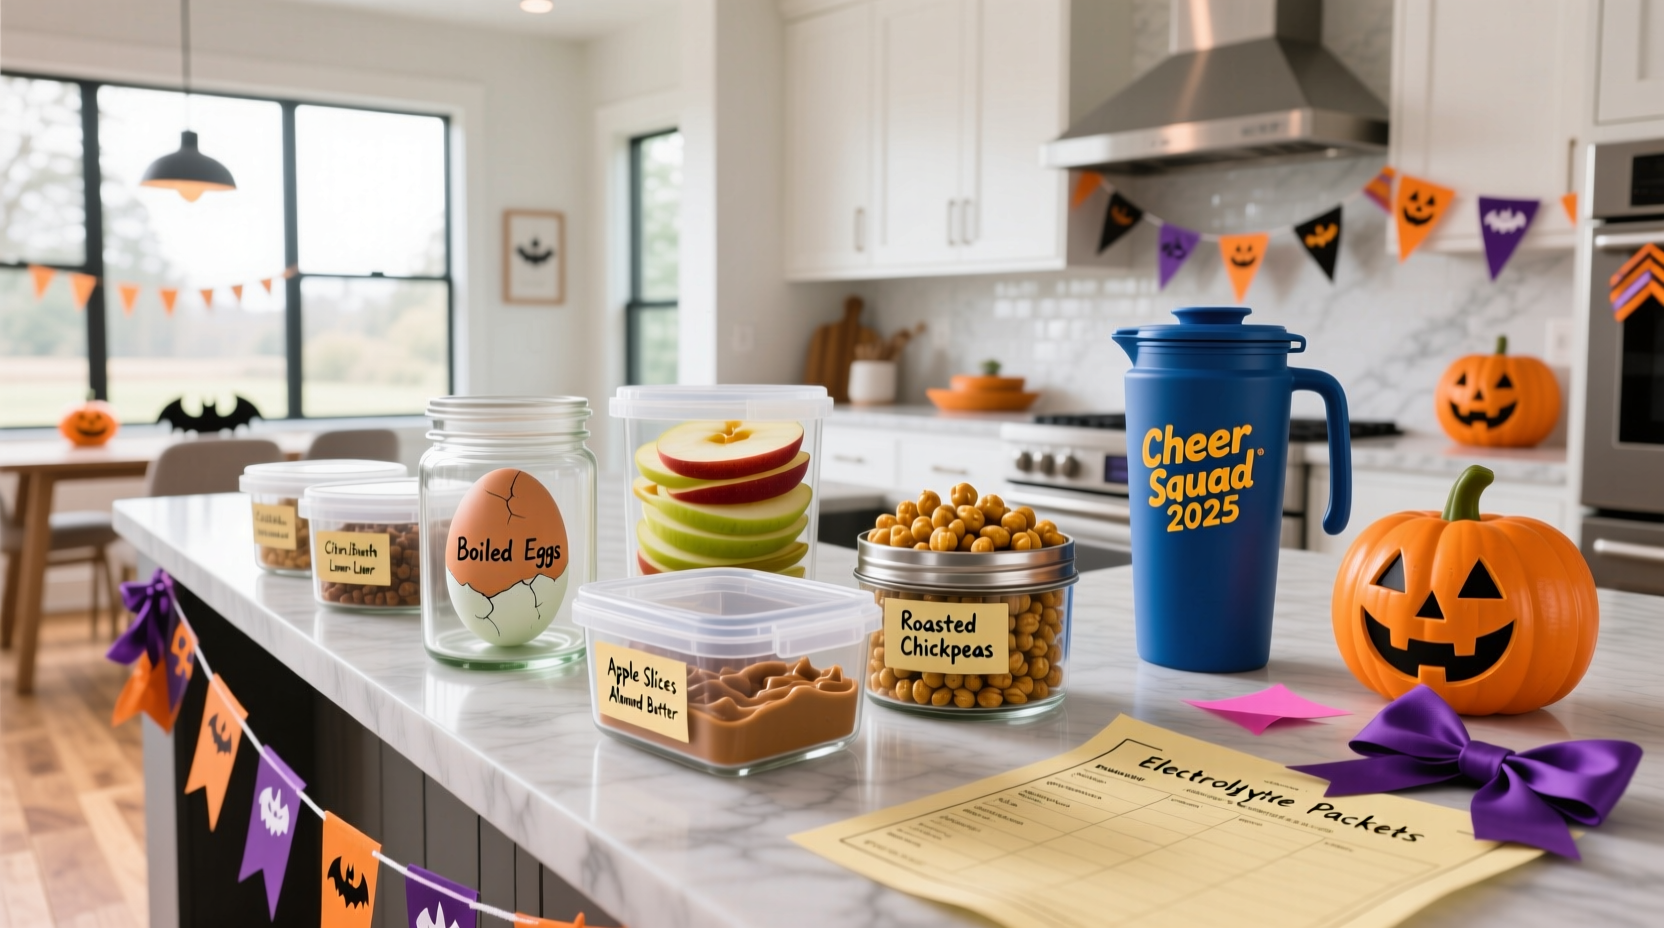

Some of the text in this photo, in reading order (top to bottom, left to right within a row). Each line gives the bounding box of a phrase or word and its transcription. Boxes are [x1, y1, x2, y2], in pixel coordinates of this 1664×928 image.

[1142, 424, 1253, 468] Cheer
[1148, 448, 1255, 508] Squad
[1167, 494, 1240, 532] 2025
[457, 536, 561, 569] Boiled Eggs
[901, 609, 977, 633] Roasted
[900, 635, 994, 665] Chickpeas
[607, 656, 677, 695] Apple Slices
[1306, 802, 1425, 842] Packets
